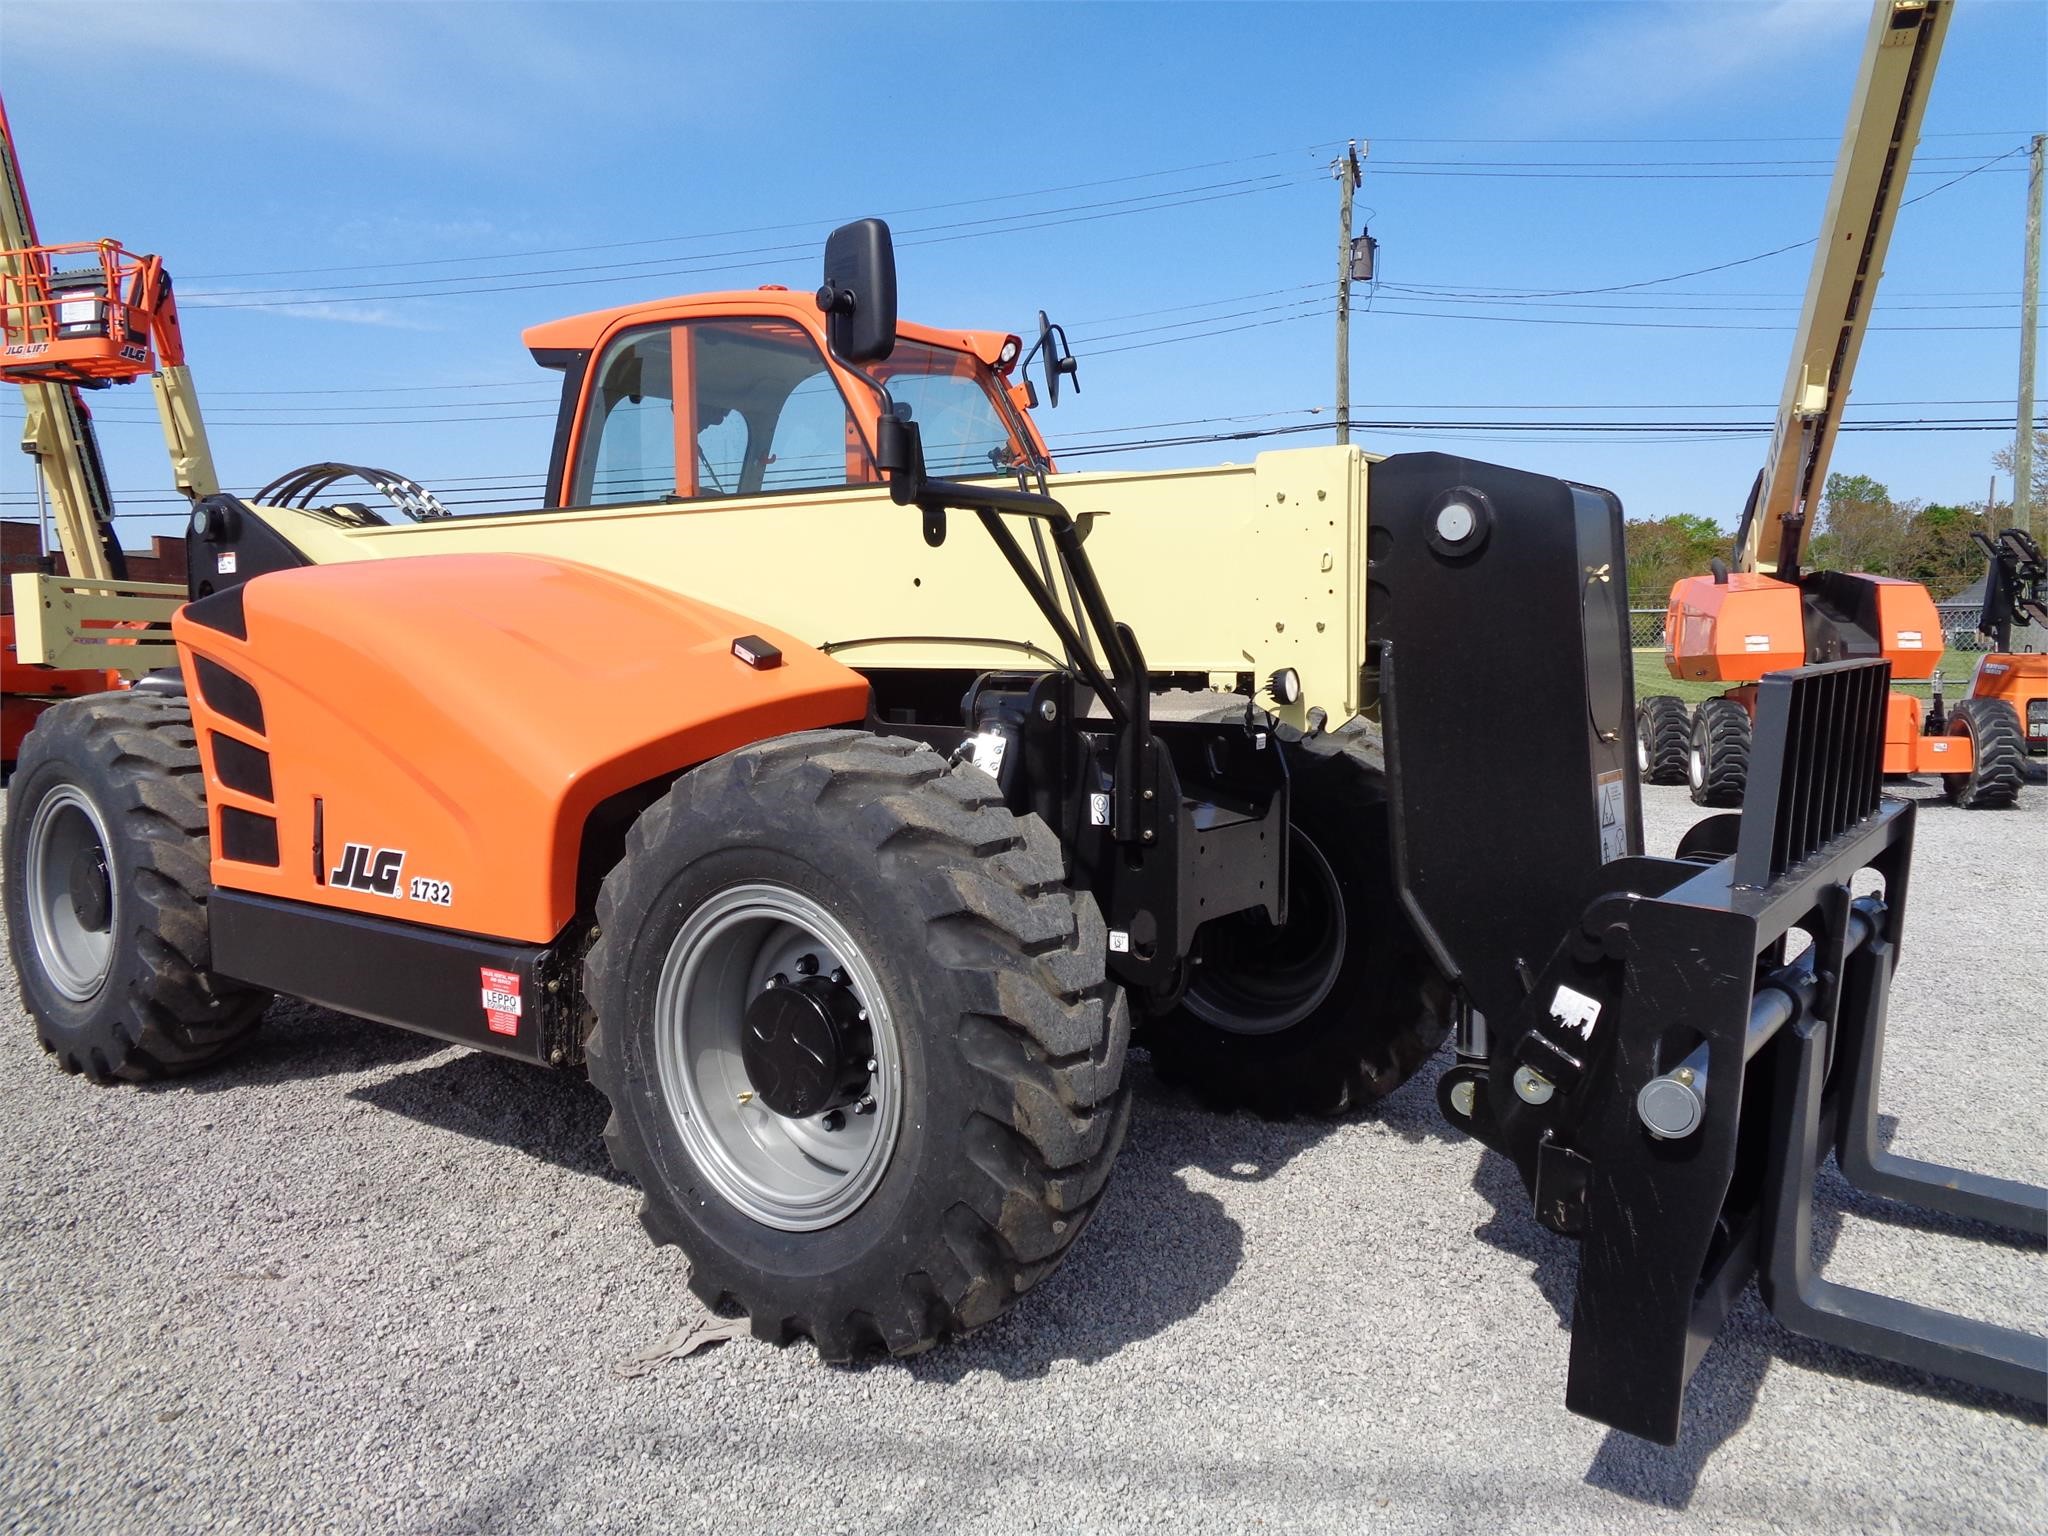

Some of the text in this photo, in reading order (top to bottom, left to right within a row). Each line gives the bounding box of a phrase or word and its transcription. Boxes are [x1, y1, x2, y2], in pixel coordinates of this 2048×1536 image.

[6, 343, 49, 355] JLG LIFT
[120, 345, 146, 362] JLG
[331, 845, 403, 895] JLG
[411, 879, 450, 905] 1732
[486, 991, 517, 1007] LEPPO
[486, 1001, 517, 1013] EQUIPMENT
